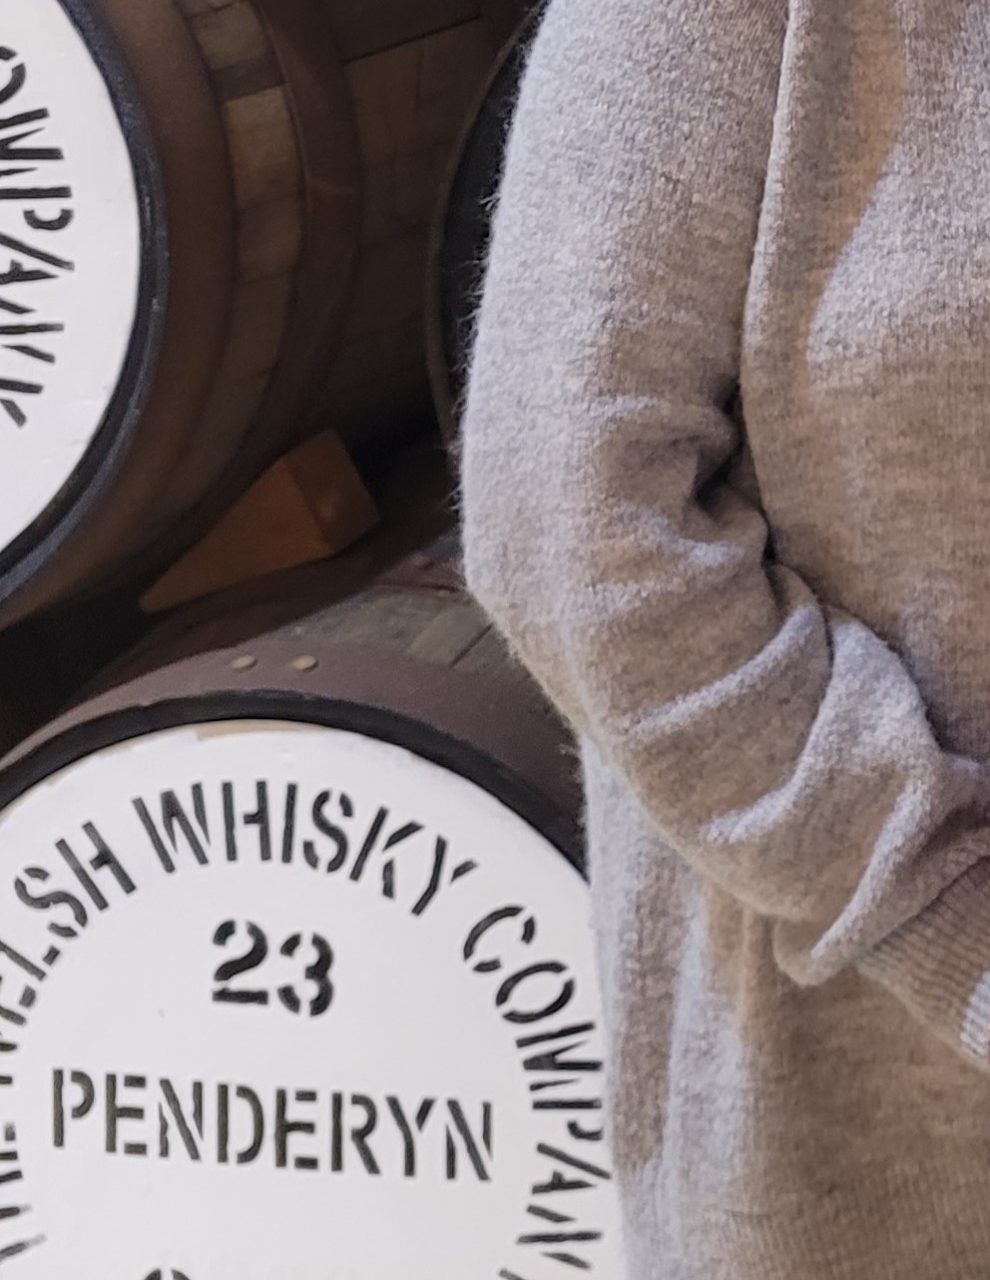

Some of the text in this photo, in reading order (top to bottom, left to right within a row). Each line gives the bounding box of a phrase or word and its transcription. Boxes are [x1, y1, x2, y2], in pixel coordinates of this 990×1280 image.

[212, 919, 334, 1016] 23
[133, 780, 478, 916] WHISKY
[463, 904, 611, 1280] COMPAN
[52, 1068, 494, 1181] PENDERYN
